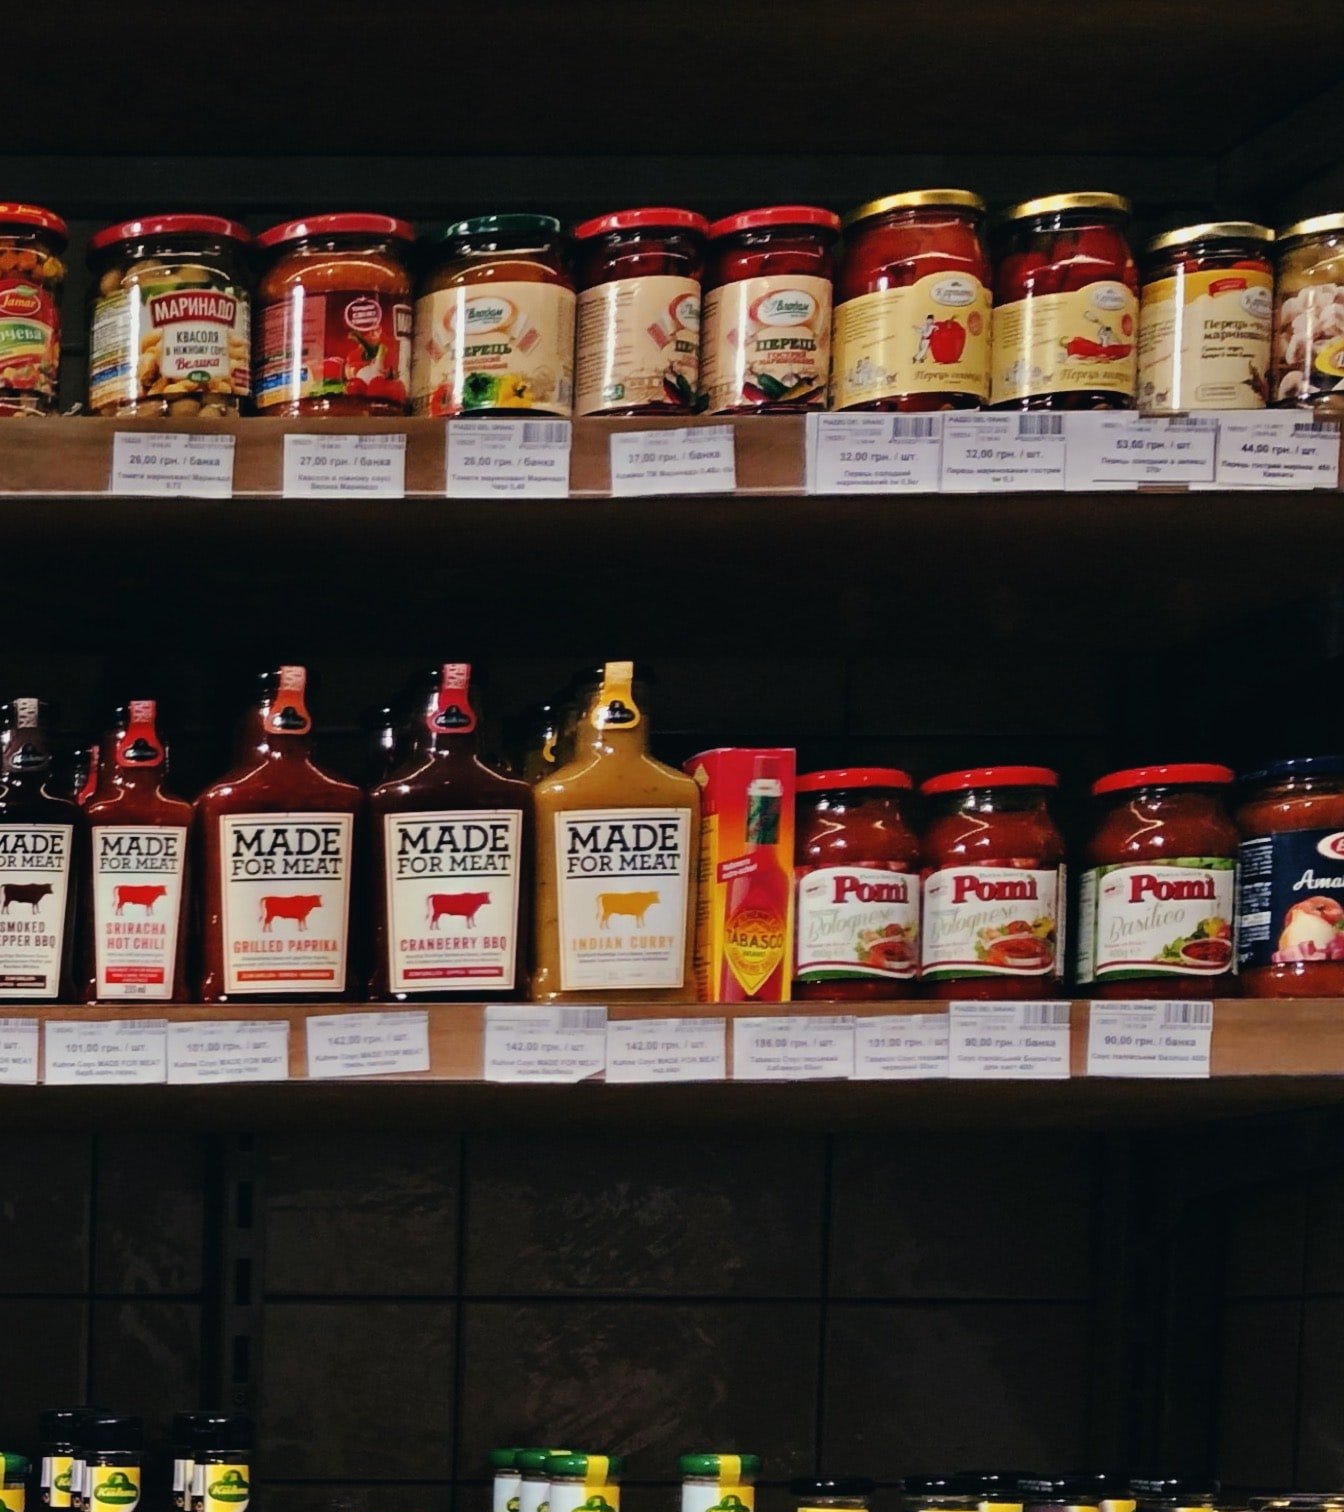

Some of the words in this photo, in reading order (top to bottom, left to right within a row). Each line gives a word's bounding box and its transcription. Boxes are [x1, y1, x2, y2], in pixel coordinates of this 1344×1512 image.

[2, 297, 37, 310] Jamar
[154, 301, 234, 321] МАРИНАДО
[176, 331, 219, 344] КВАСОЛЯ
[175, 356, 219, 371] Велика
[232, 828, 340, 856] MADE
[232, 859, 274, 876] FOR
[283, 858, 342, 874] MEAT
[0, 921, 45, 933] SMOKED
[106, 923, 166, 935] SRIRACHA
[1110, 908, 1185, 940] Basilico
[35, 936, 55, 948] BBQ
[108, 937, 128, 950] HOT
[133, 938, 164, 950] CHILI
[573, 937, 623, 950] INDIAN
[630, 937, 674, 949] CURRY
[727, 929, 783, 946] TABASCO
[233, 940, 285, 953] GRILLED
[288, 940, 338, 952] PAPRIKA
[400, 937, 477, 952] CRANBERRY
[484, 937, 507, 951] BBQ
